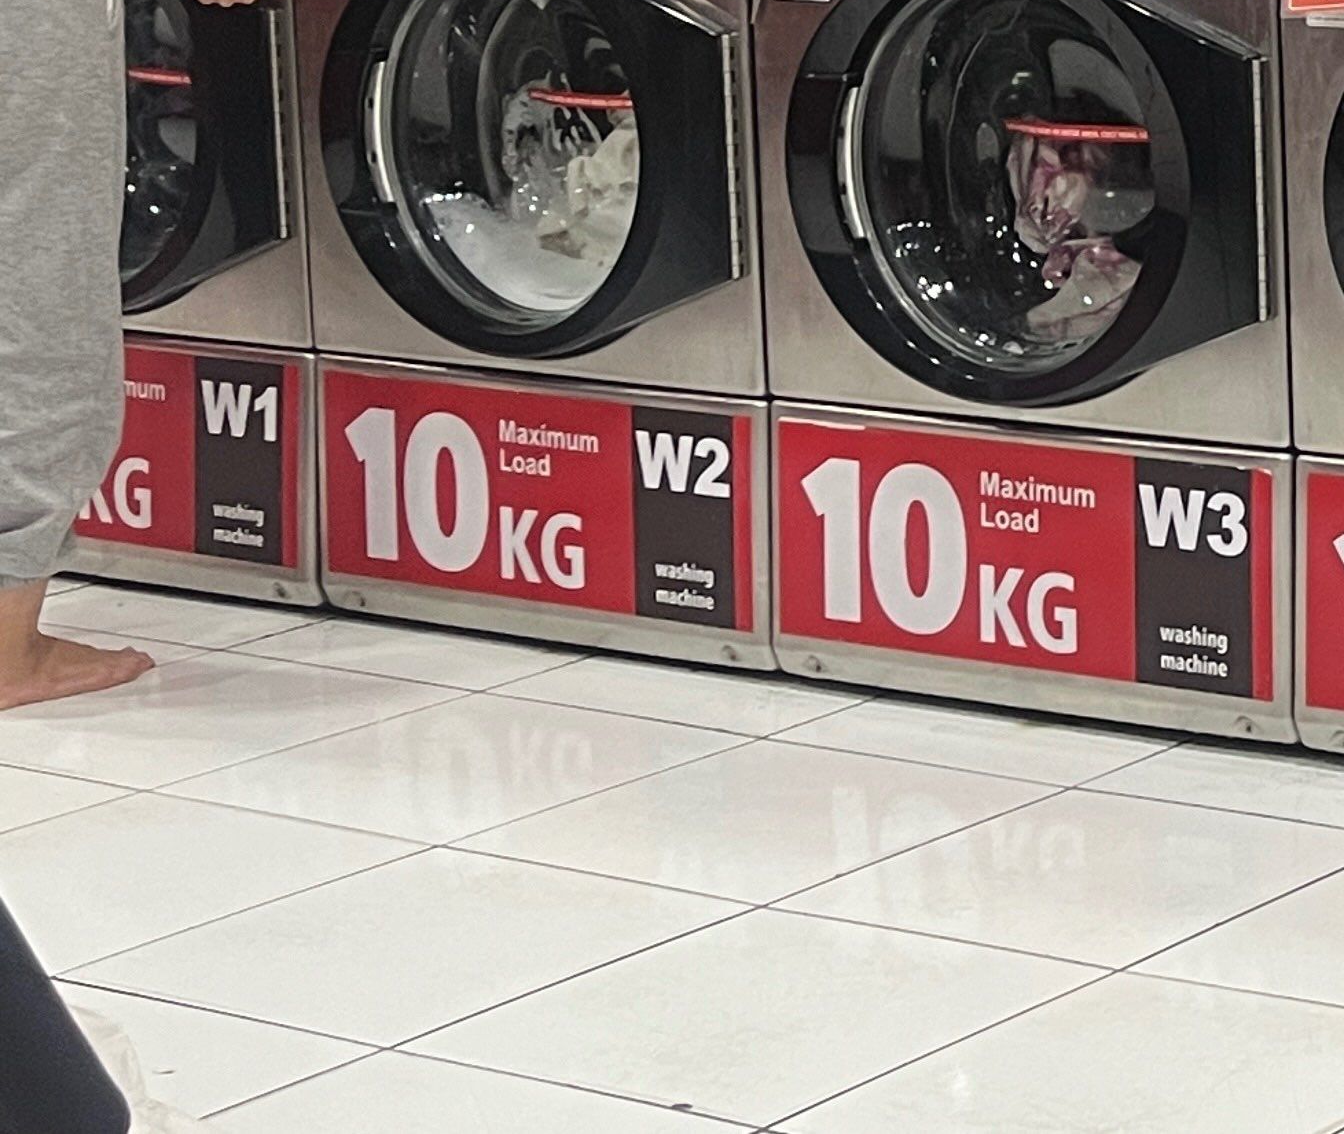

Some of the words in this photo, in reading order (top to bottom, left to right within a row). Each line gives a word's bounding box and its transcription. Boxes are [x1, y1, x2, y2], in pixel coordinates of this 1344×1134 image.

[201, 380, 277, 442] W1
[499, 418, 599, 454] Maximum
[499, 448, 551, 477] Load
[636, 430, 731, 498] W2
[345, 407, 489, 572] 10
[499, 506, 585, 589] KG
[980, 471, 1096, 508] Maximum
[980, 503, 1040, 533] Load
[1139, 484, 1248, 557] W3
[801, 458, 967, 635] 10
[979, 565, 1078, 654] KG
[655, 562, 715, 590] washing
[655, 587, 715, 610] machine
[1160, 626, 1228, 651] washing
[1160, 653, 1228, 678] machine
